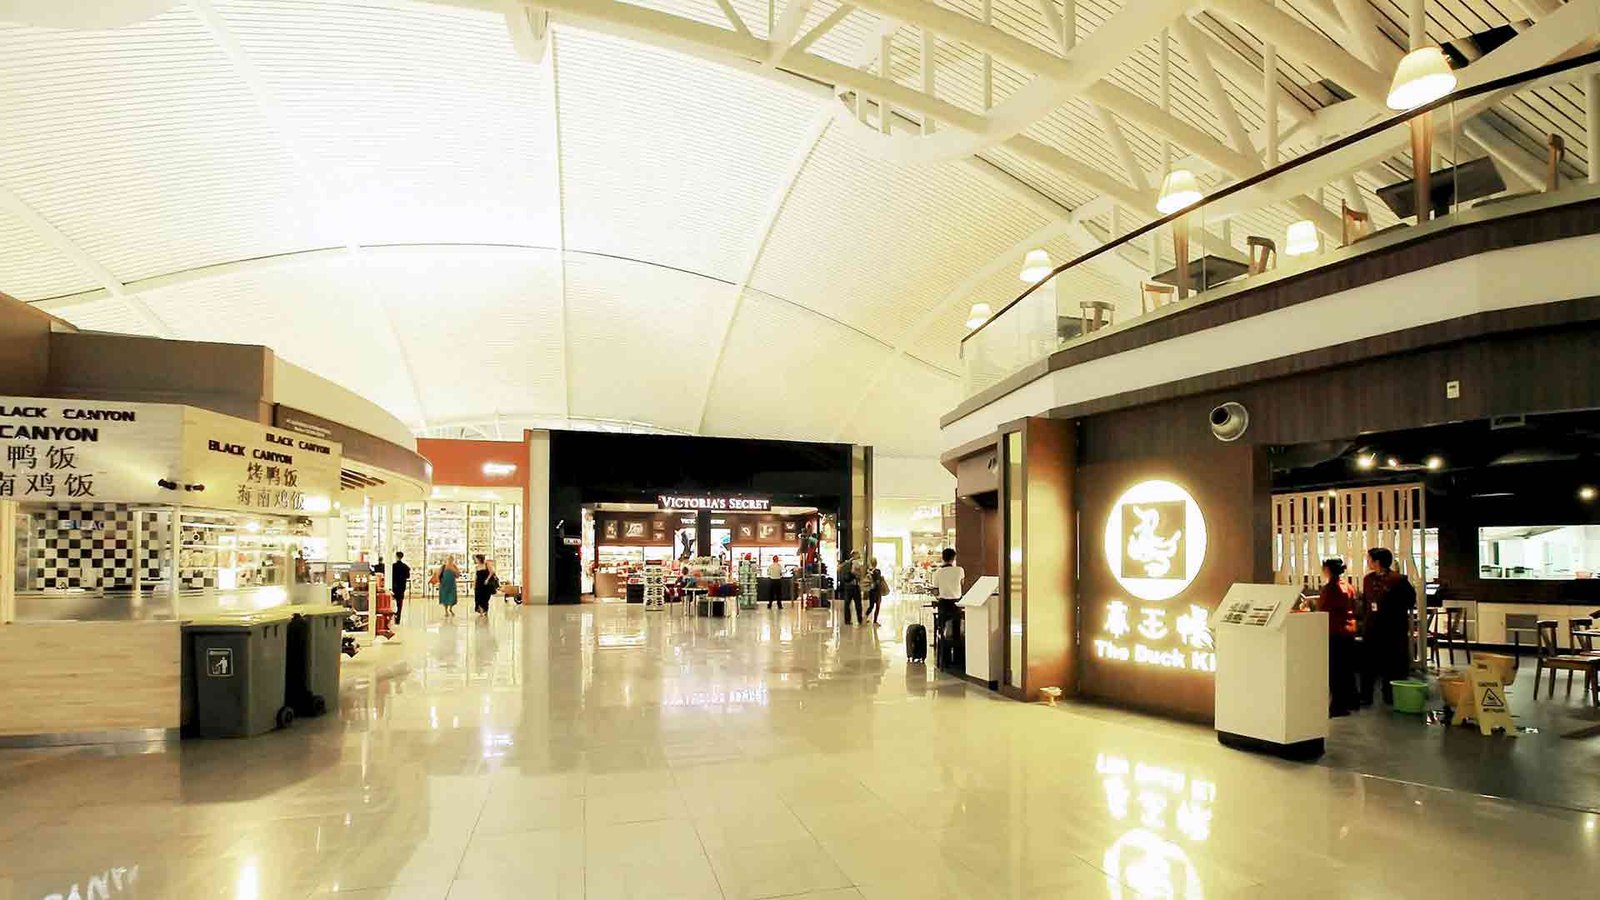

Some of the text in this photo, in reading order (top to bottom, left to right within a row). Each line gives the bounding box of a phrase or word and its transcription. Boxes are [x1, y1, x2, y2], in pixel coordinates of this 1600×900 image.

[63, 409, 135, 421] CANYON
[208, 440, 292, 465] BLACK CANYON
[266, 433, 330, 455] BLACK CANYON
[247, 461, 298, 487] 烤鸭饭
[238, 485, 305, 510] 海南鸡饭
[659, 496, 769, 509] VICTORIA'S SECRET
[1094, 639, 1129, 660] The
[1134, 643, 1186, 669] Duck
